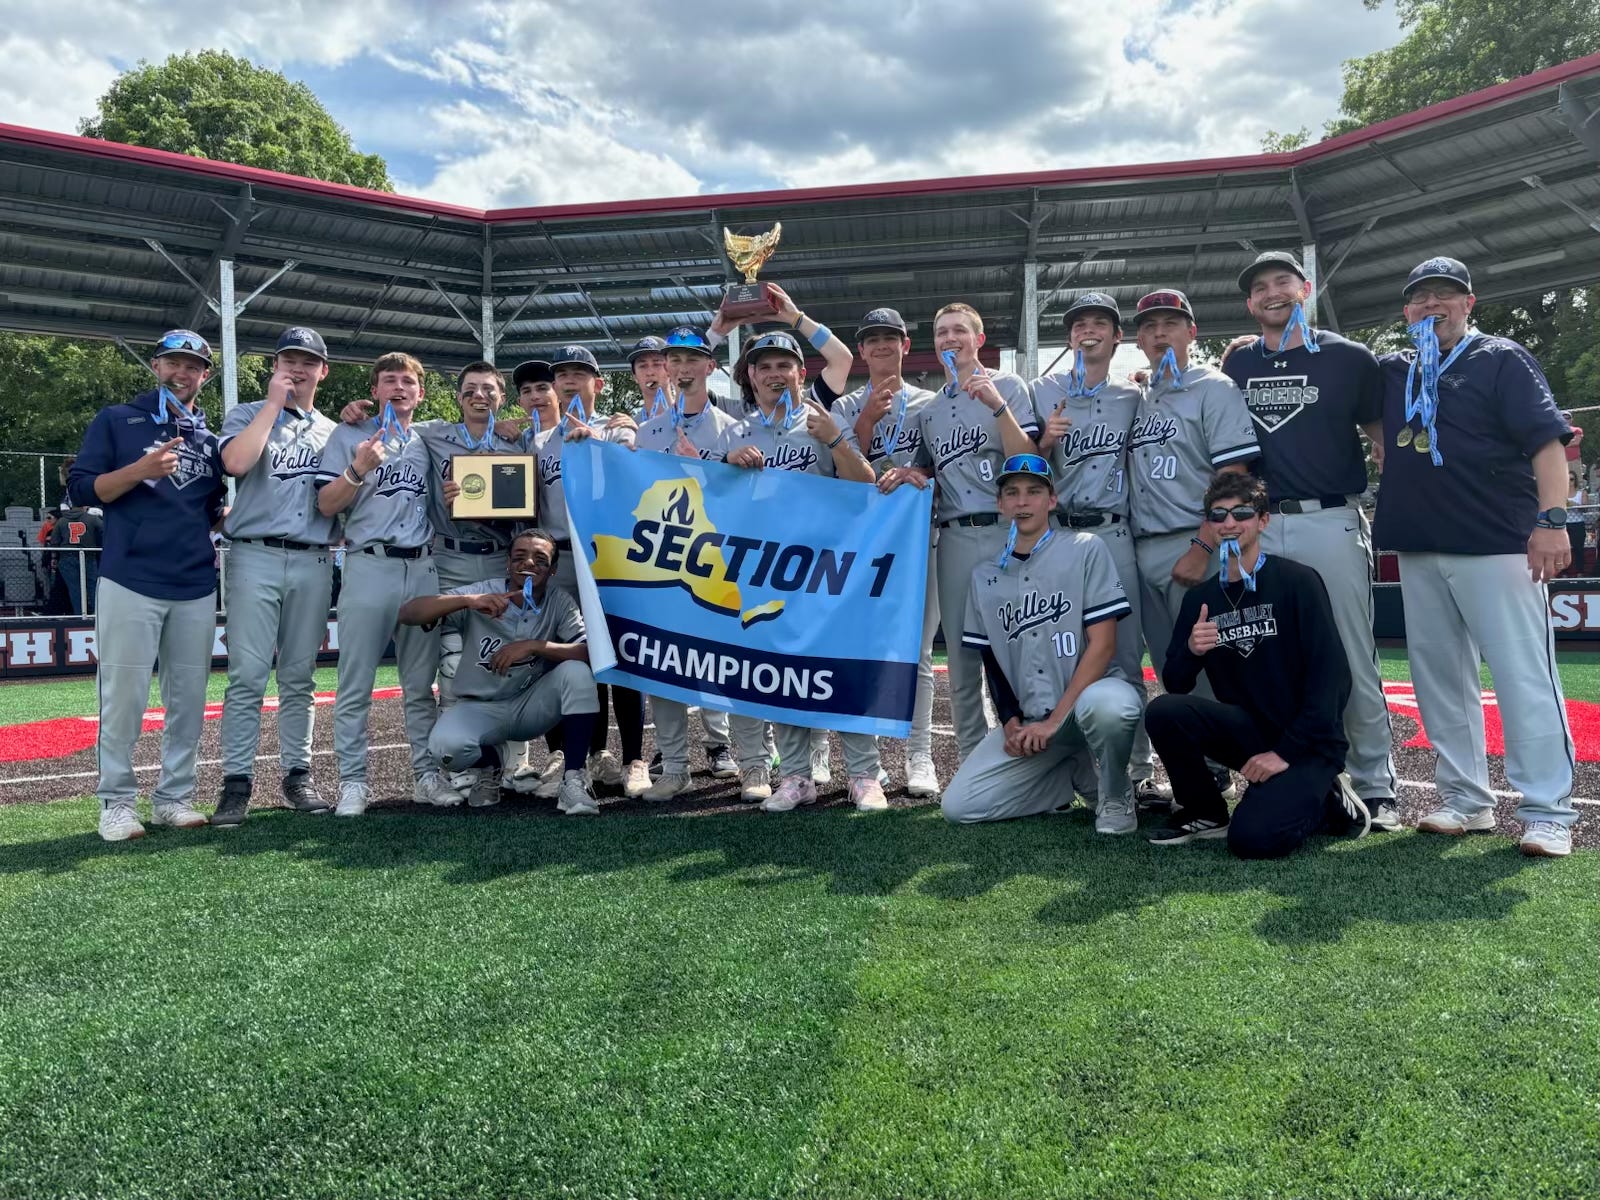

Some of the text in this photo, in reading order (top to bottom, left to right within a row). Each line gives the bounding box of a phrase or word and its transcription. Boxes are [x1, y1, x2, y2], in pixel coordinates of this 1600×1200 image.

[270, 447, 322, 472] Valle
[763, 443, 817, 471] alley
[979, 459, 994, 481] 9
[1151, 455, 1178, 480] 20
[375, 463, 427, 498] Valley
[1105, 467, 1124, 493] 21
[68, 522, 86, 544] P
[626, 519, 896, 597] SECTION 1
[1051, 631, 1077, 658] 10
[618, 632, 834, 701] CHAMPIONS
